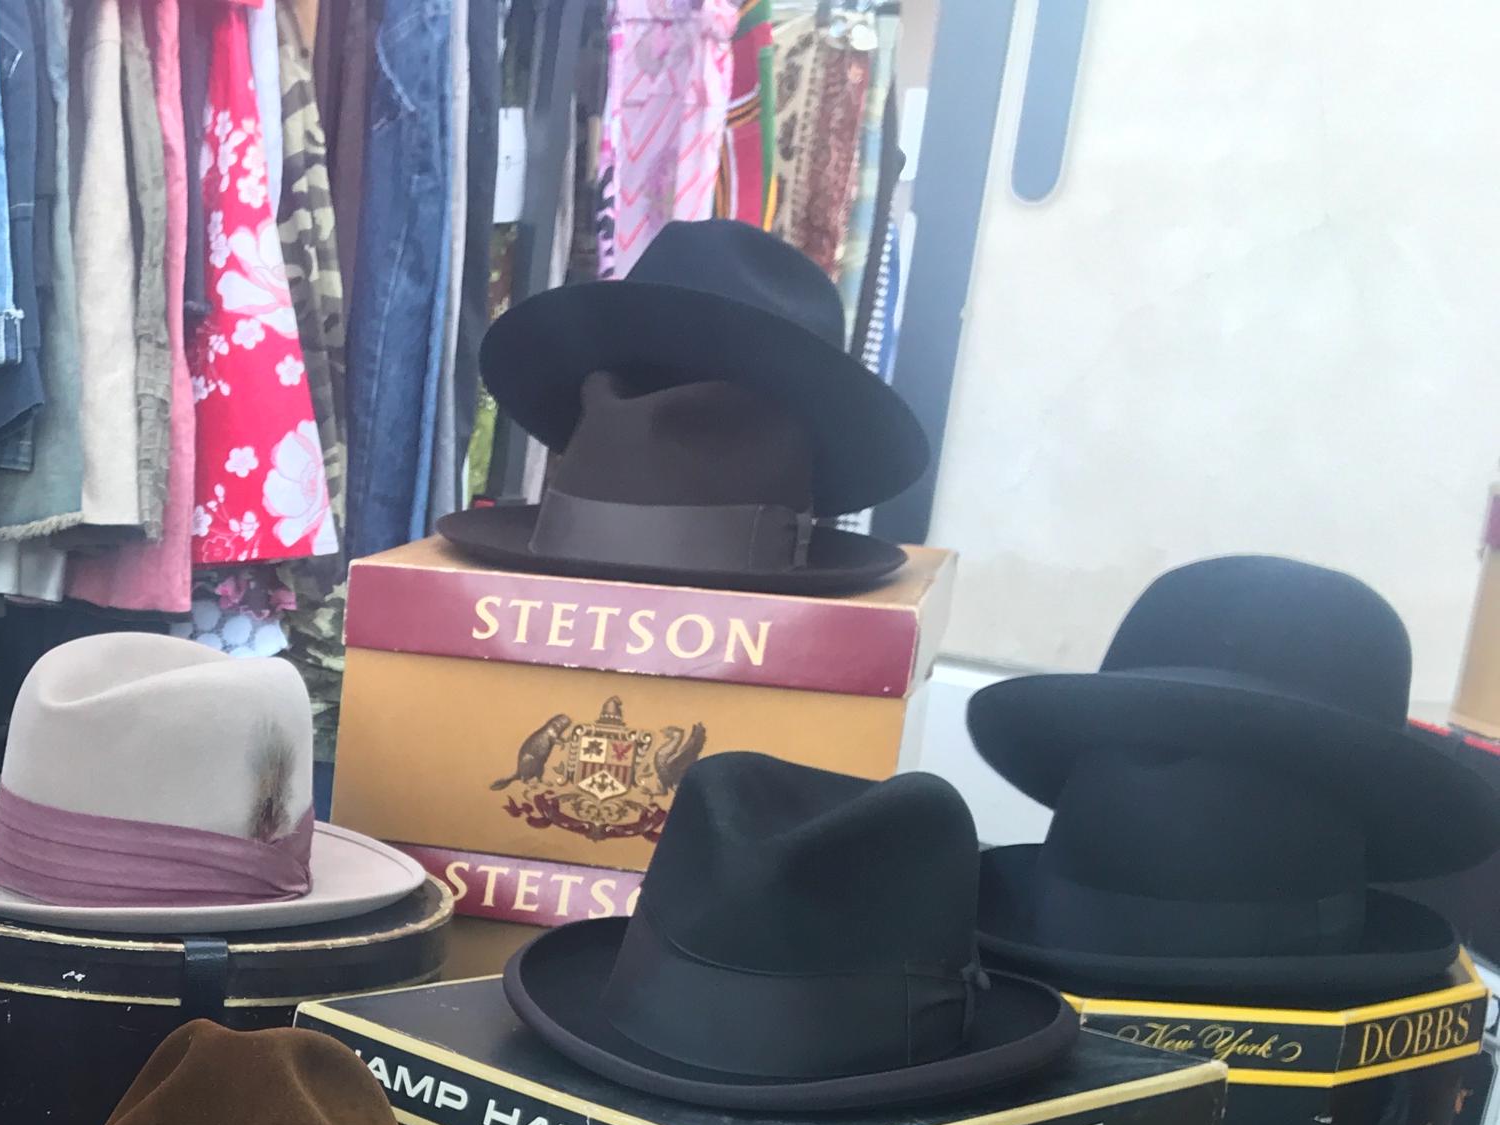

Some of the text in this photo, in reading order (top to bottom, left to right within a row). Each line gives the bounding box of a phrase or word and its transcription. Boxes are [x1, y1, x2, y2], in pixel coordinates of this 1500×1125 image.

[471, 595, 773, 667] STETSON
[445, 861, 642, 919] STETS
[1117, 1022, 1279, 1061] New York
[1358, 1002, 1473, 1067] DOBBS
[355, 1049, 469, 1112] AMP
